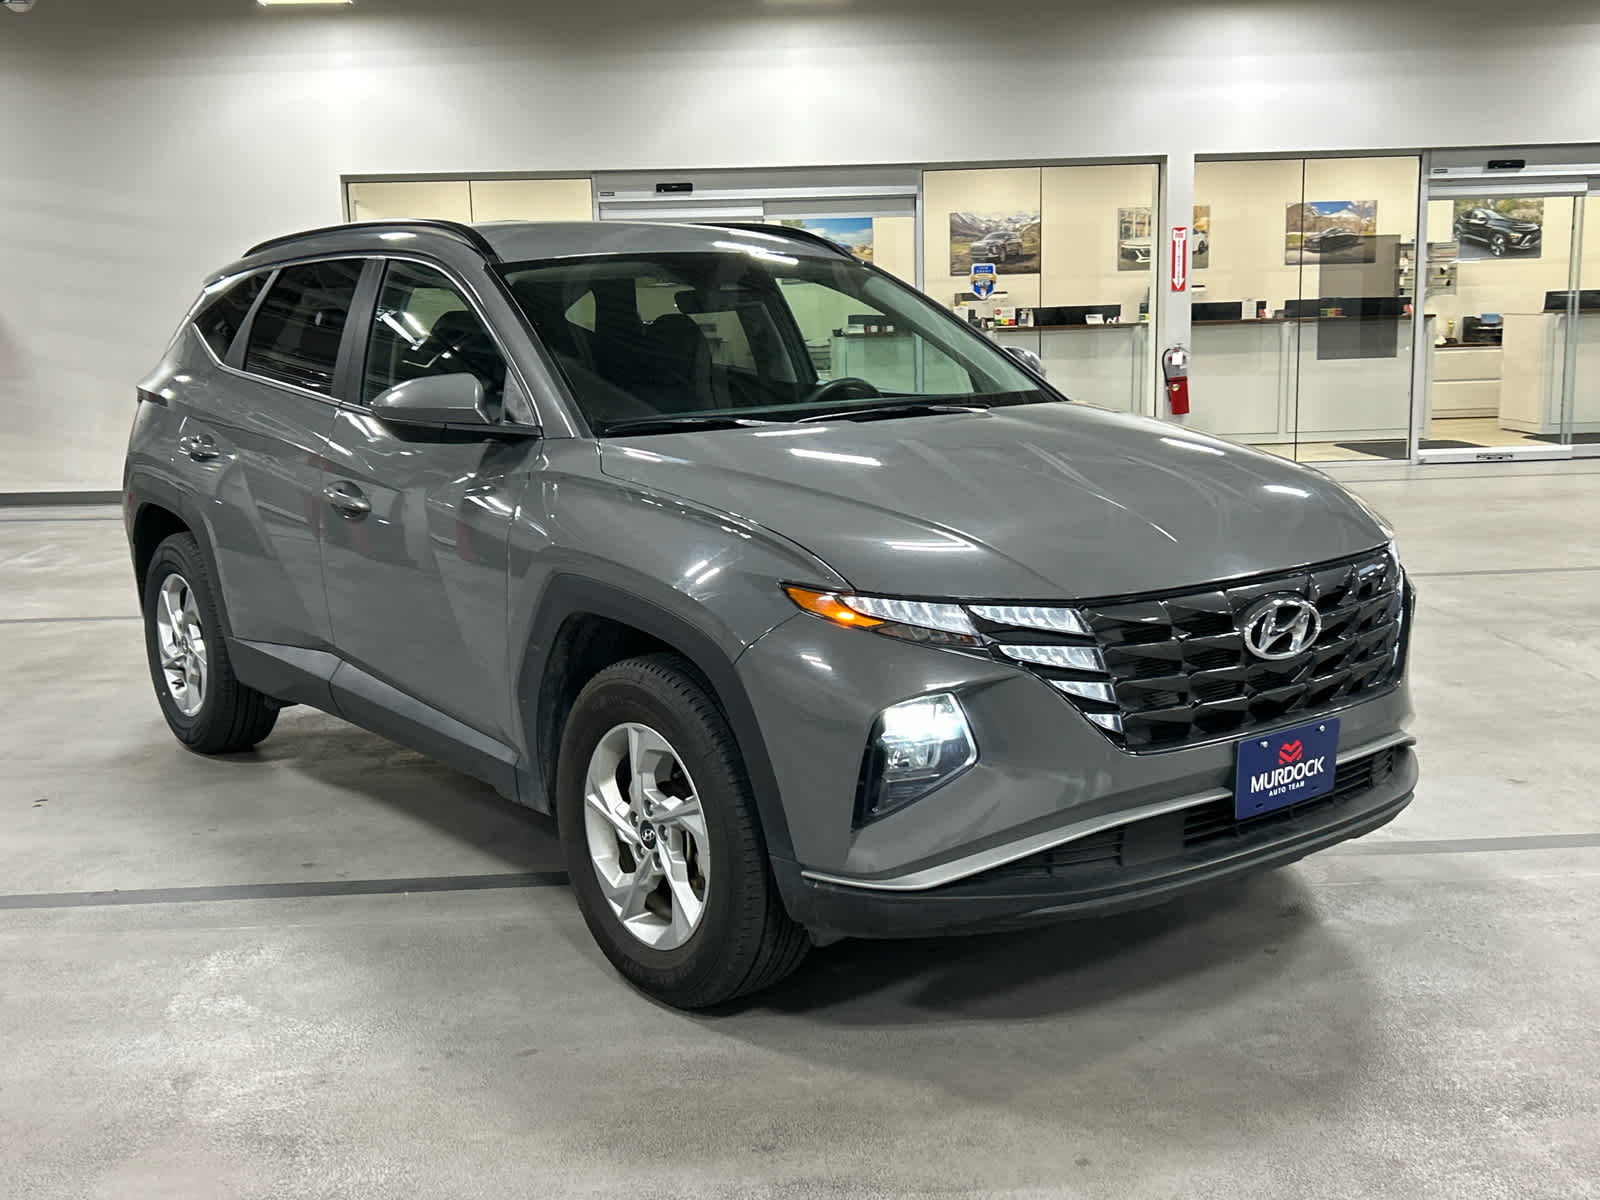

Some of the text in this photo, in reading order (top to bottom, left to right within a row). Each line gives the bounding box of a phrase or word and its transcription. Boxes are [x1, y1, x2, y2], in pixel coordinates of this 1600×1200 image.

[1251, 756, 1325, 793] MURDOCK
[1269, 781, 1305, 797] AUTO TEAM
